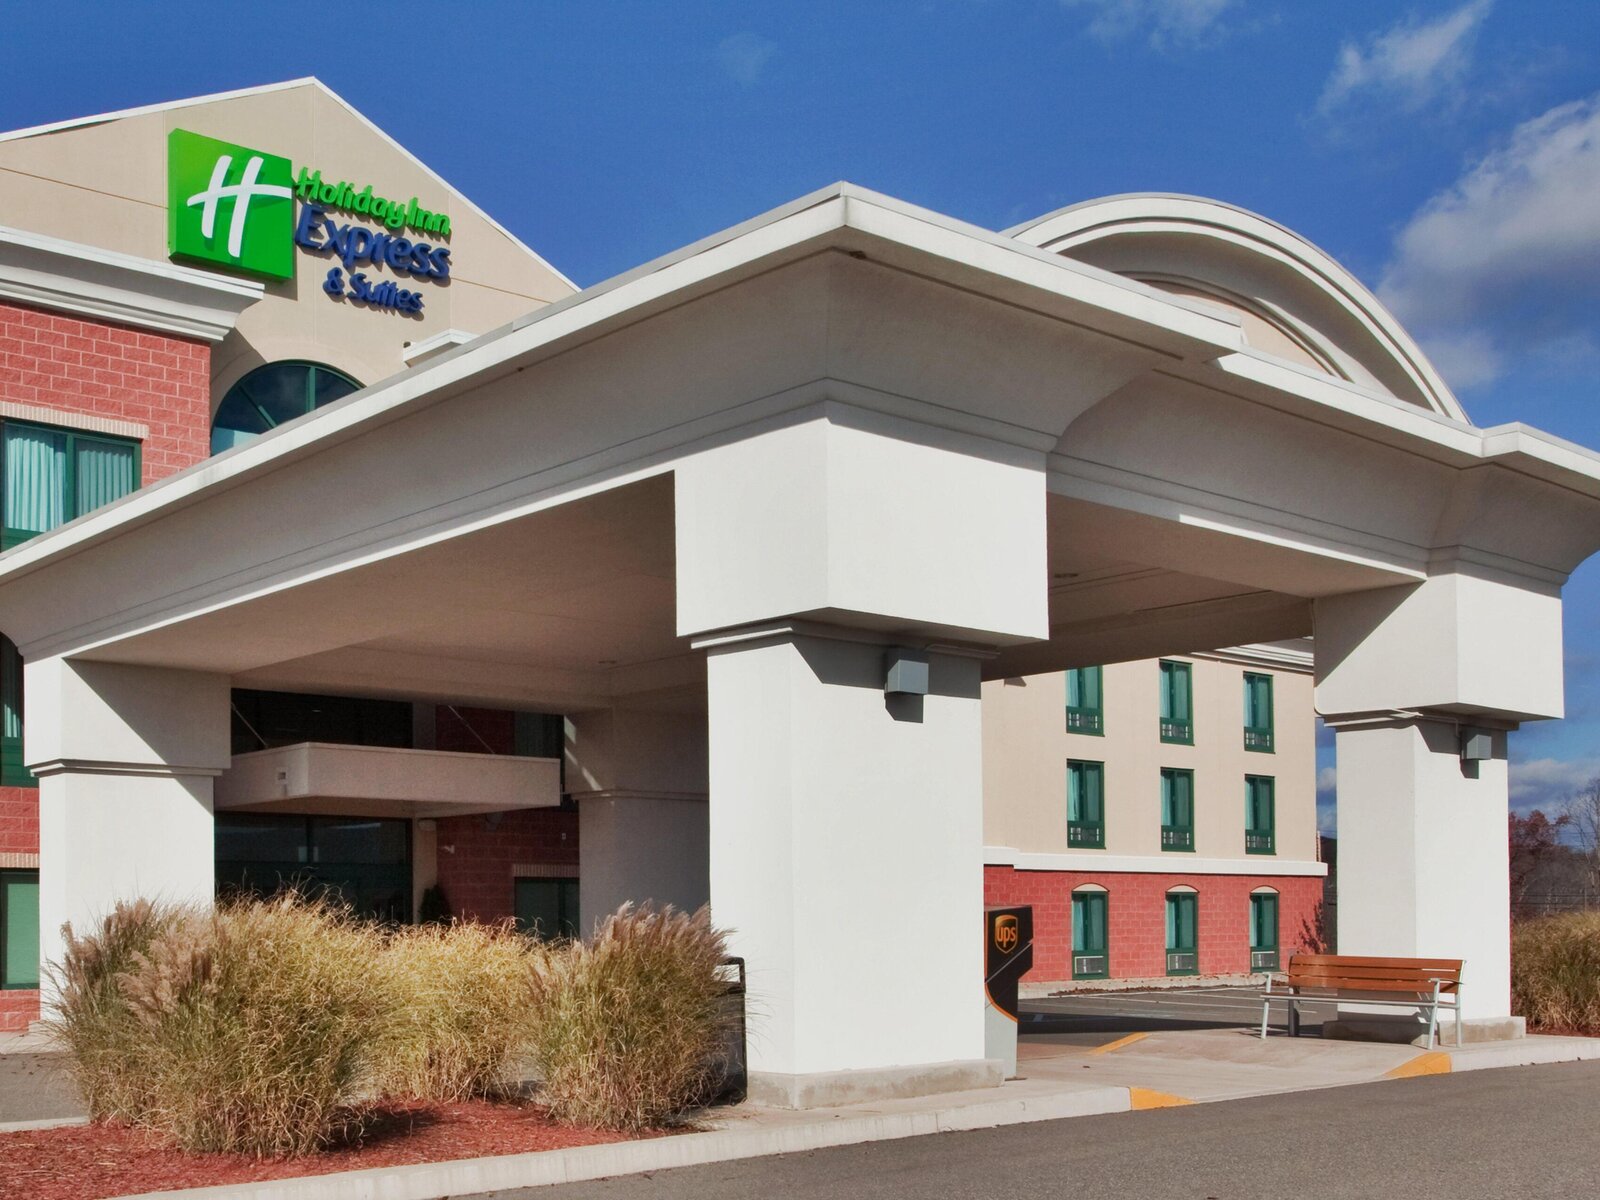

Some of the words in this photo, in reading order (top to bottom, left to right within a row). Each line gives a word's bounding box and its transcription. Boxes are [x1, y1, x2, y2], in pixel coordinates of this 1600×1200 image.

[296, 167, 405, 228] Holiday
[405, 197, 451, 235] Inn
[295, 203, 452, 279] Express
[323, 267, 345, 296] &
[348, 272, 424, 313] Suites
[996, 926, 1017, 948] ups
